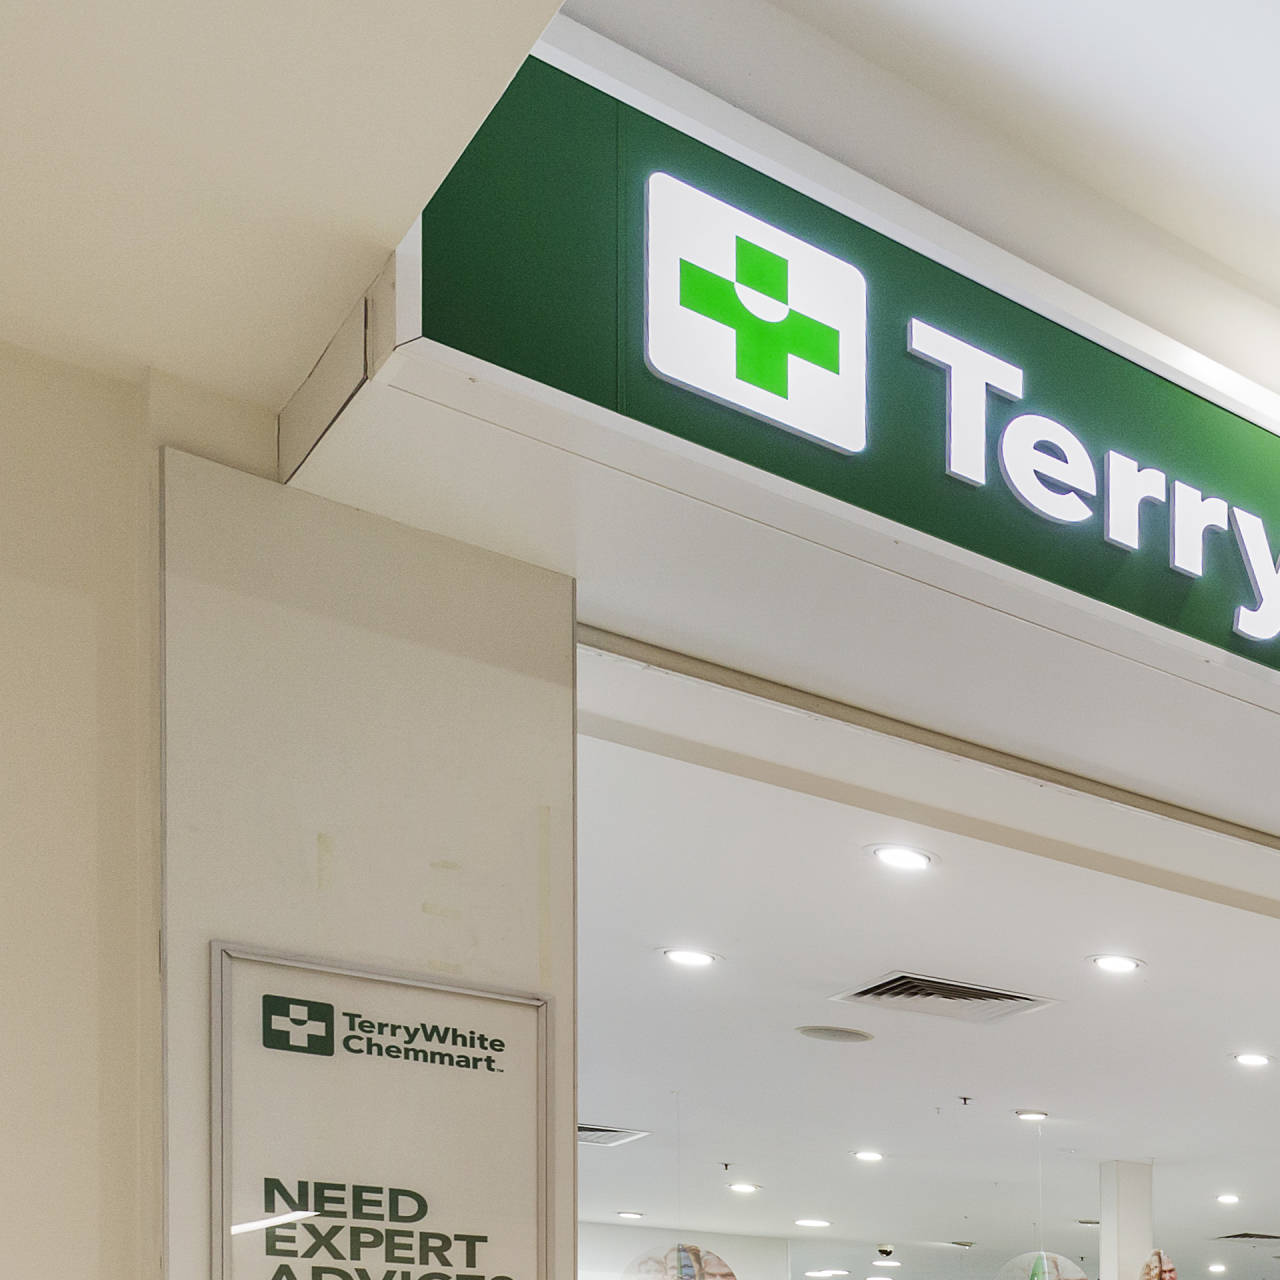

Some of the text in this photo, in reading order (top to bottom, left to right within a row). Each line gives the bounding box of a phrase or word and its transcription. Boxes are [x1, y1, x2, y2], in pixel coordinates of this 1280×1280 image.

[342, 1011, 506, 1054] TerryWhite
[342, 1035, 505, 1073] Chemmart
[264, 1177, 428, 1224] NEED
[265, 1223, 488, 1268] EXPERT
